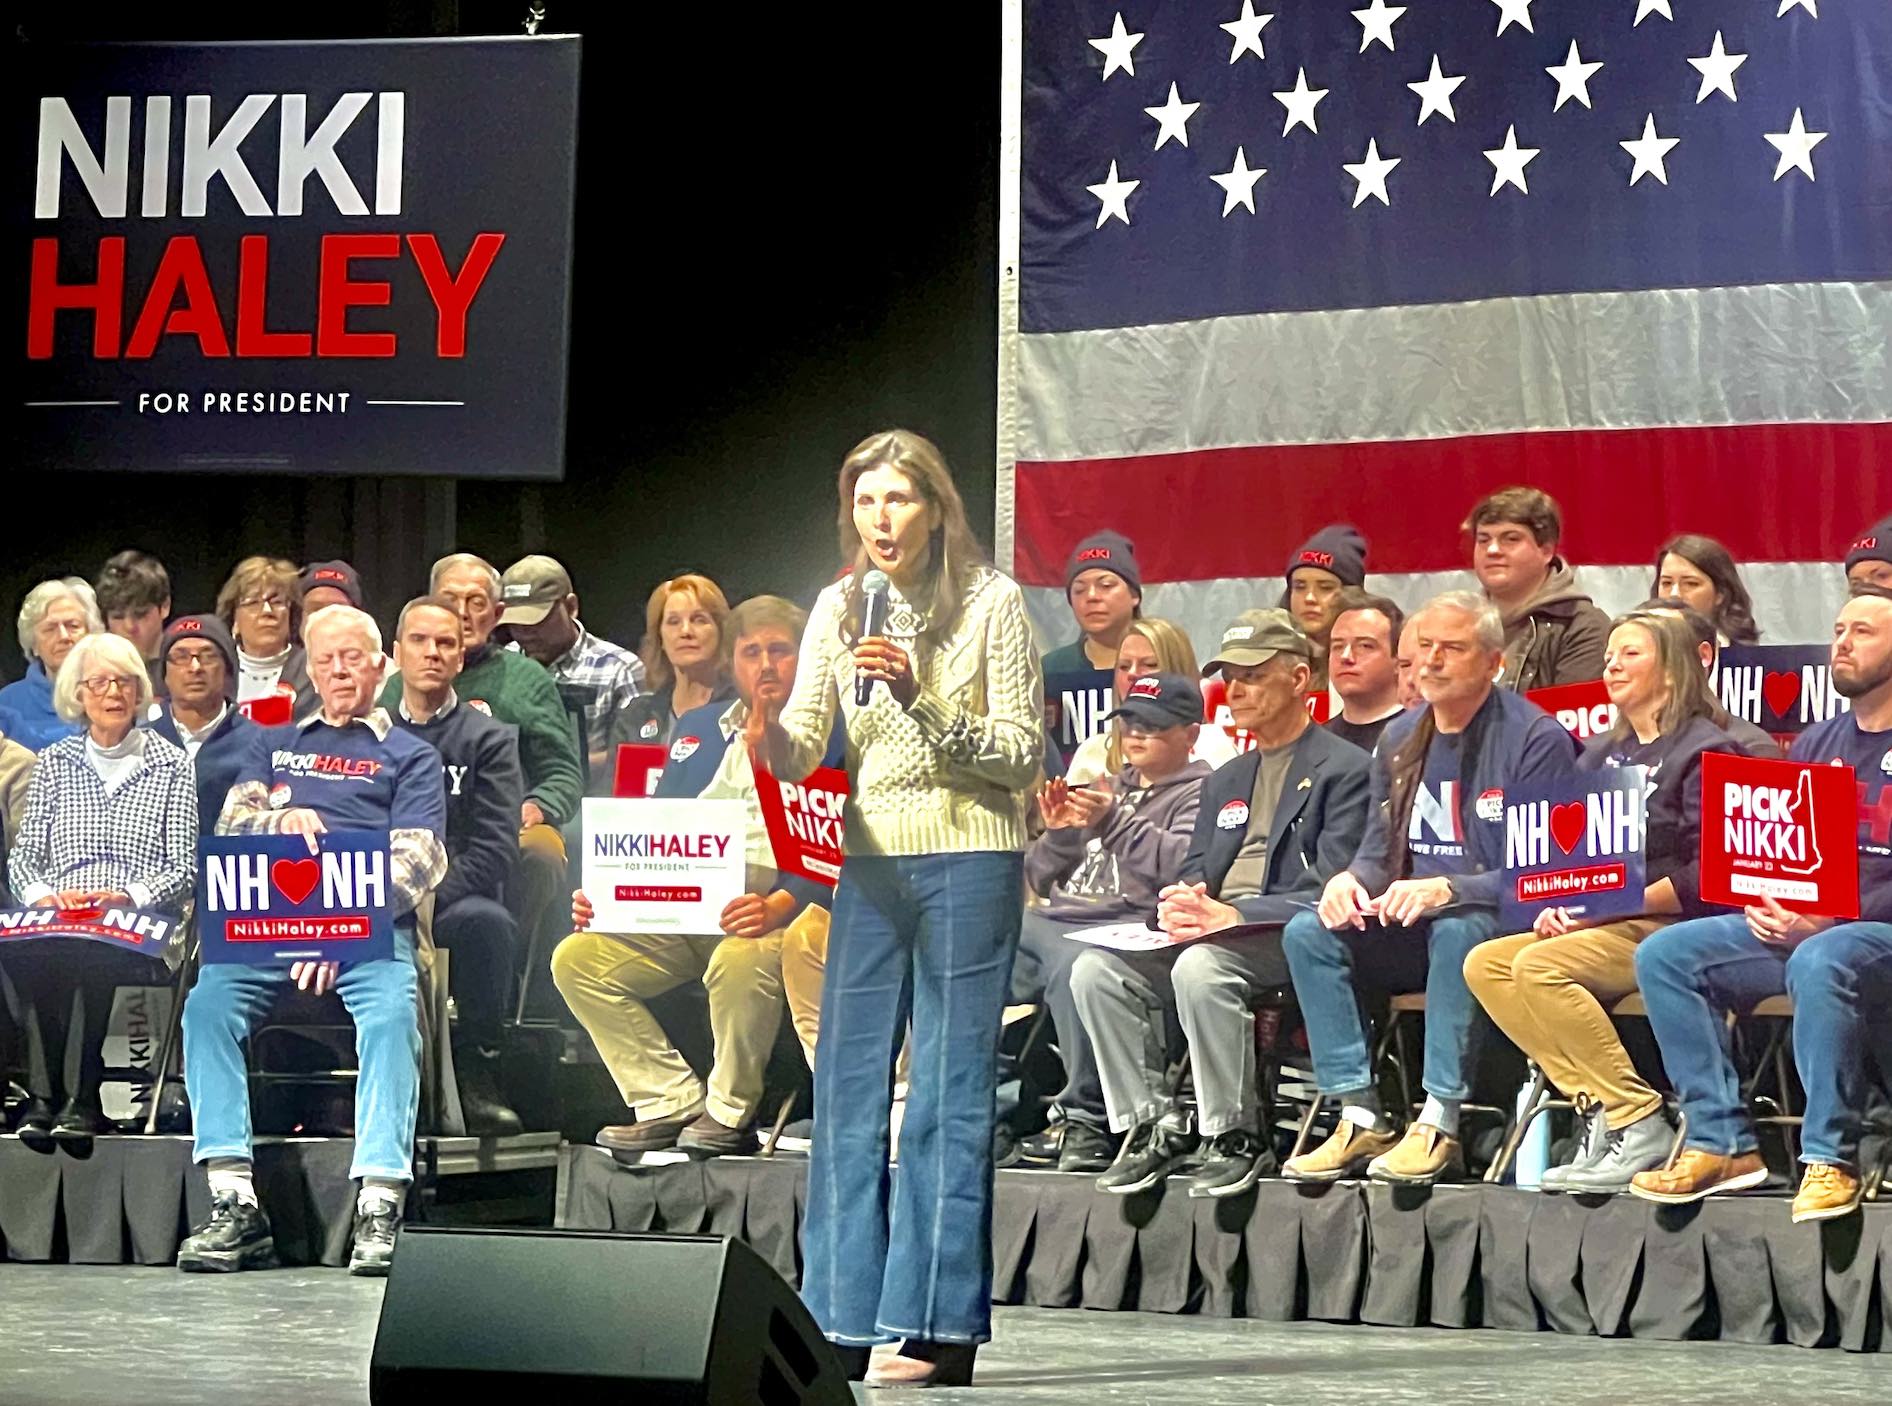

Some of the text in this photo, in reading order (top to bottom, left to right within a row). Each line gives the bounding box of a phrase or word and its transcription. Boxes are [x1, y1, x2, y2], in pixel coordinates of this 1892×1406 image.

[35, 91, 404, 219] NIKKI
[27, 233, 506, 359] HALEY
[139, 392, 350, 413] FOR PRESIDENT
[1722, 666, 1763, 724] NH
[1062, 688, 1112, 744] NH
[779, 781, 847, 819] PICK
[1724, 782, 1794, 824] PICK
[594, 833, 731, 858] NIKKIHALEY
[1506, 800, 1549, 869] NH
[1587, 788, 1639, 857] NH
[1724, 816, 1805, 861] NIKKI
[644, 863, 690, 871] PRESIDENT
[1433, 845, 1463, 856] FREE
[206, 850, 386, 911] NH NH
[1523, 873, 1619, 895] NikkiHaley.com
[0, 909, 169, 941] NH NH
[233, 921, 363, 938] NikkiHaley.com
